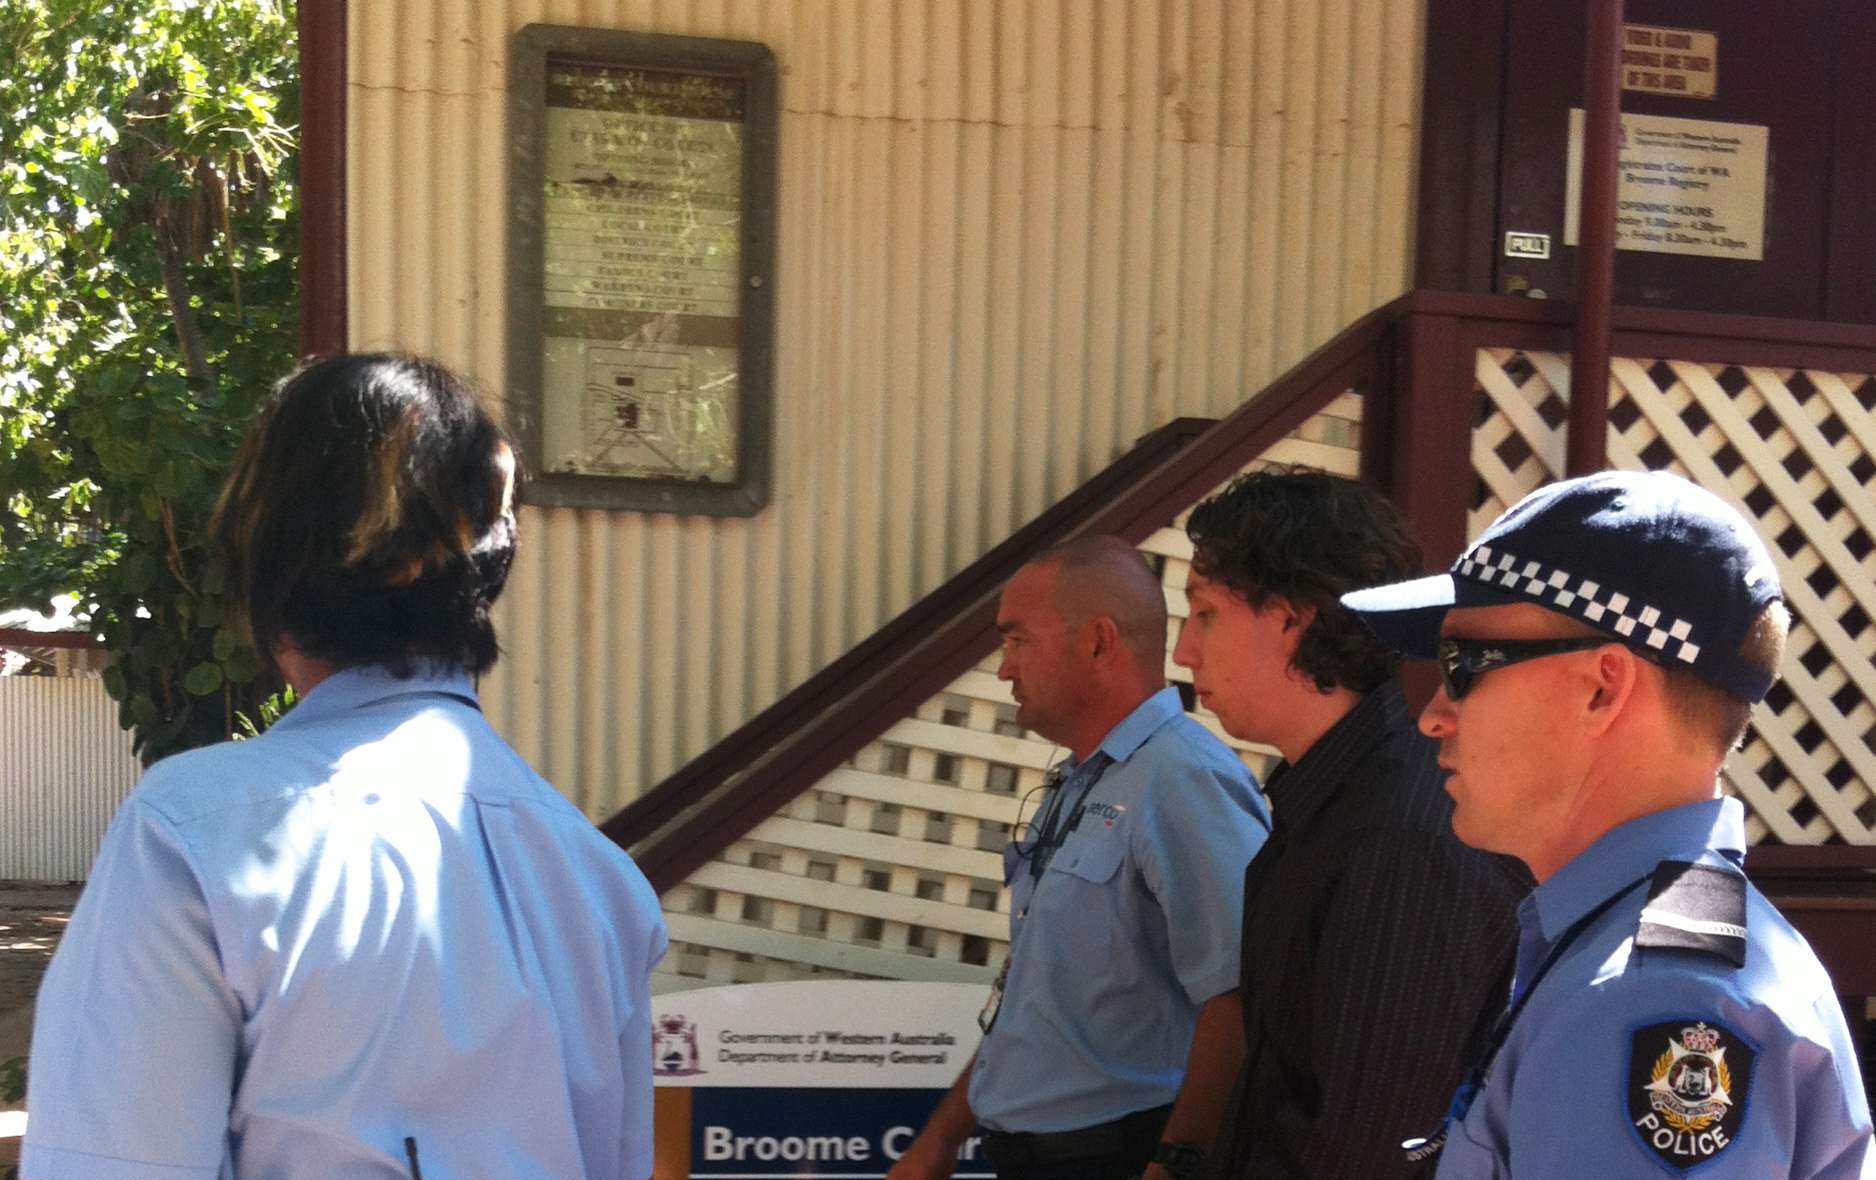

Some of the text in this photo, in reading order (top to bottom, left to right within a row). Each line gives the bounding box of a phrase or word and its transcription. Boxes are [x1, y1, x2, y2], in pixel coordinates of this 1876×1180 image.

[1673, 205, 1713, 217] HOURS
[718, 1030, 956, 1046] Government of Western Australia
[718, 1048, 947, 1067] Department of Attorney General
[1635, 1112, 1729, 1155] POLICE
[703, 1126, 870, 1161] Broome
